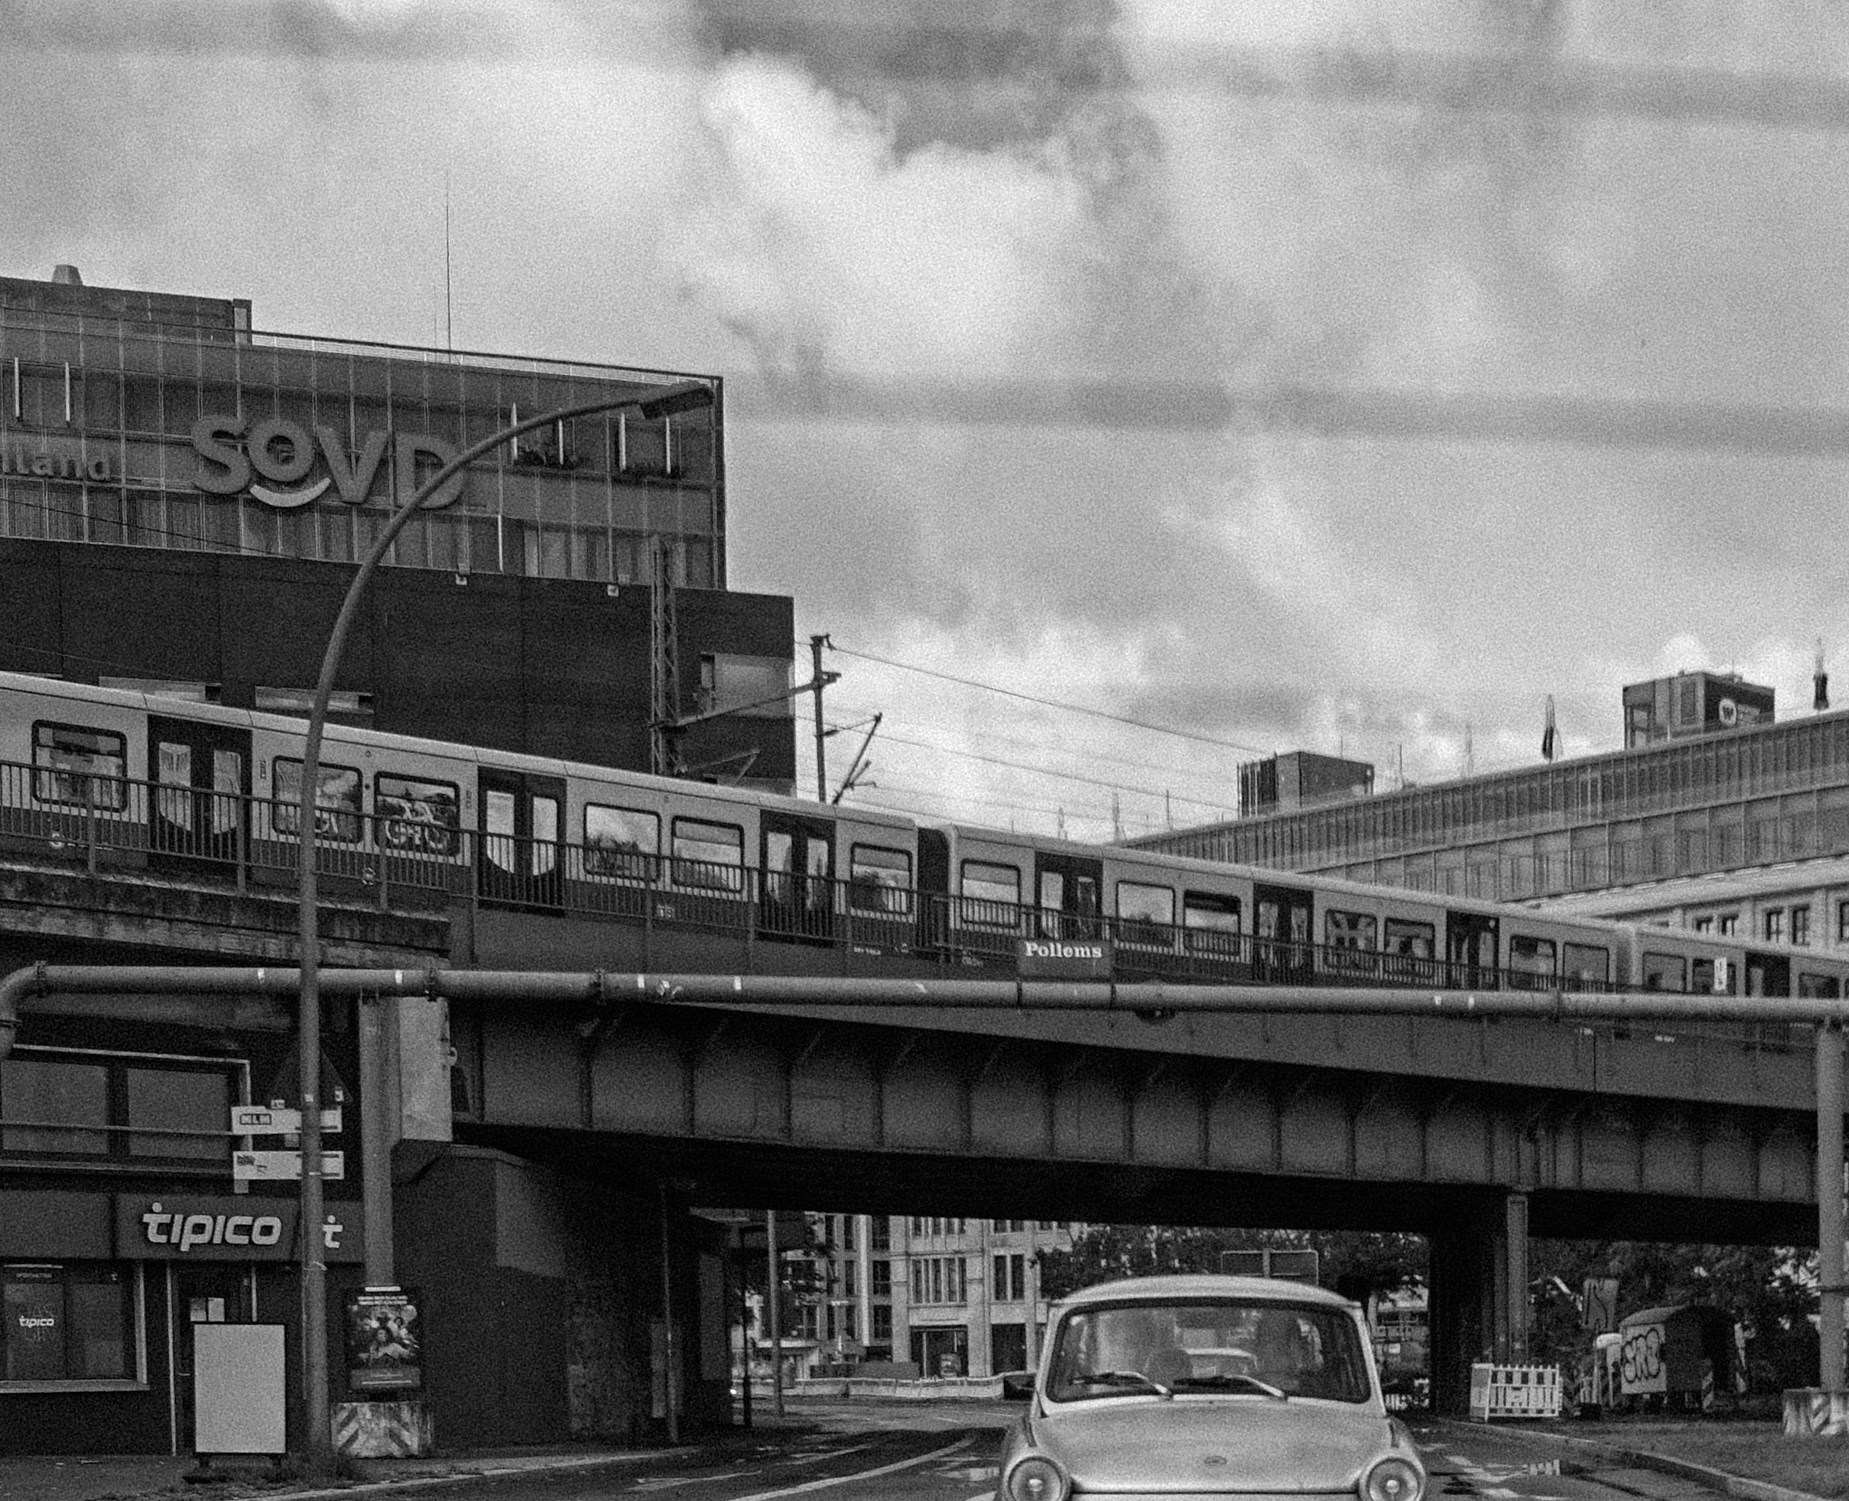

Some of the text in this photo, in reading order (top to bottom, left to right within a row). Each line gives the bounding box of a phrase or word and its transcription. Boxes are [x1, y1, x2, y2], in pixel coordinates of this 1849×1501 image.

[1025, 941, 1102, 958] Pollems
[143, 1202, 281, 1252] tipico
[19, 1315, 54, 1328] tipico
